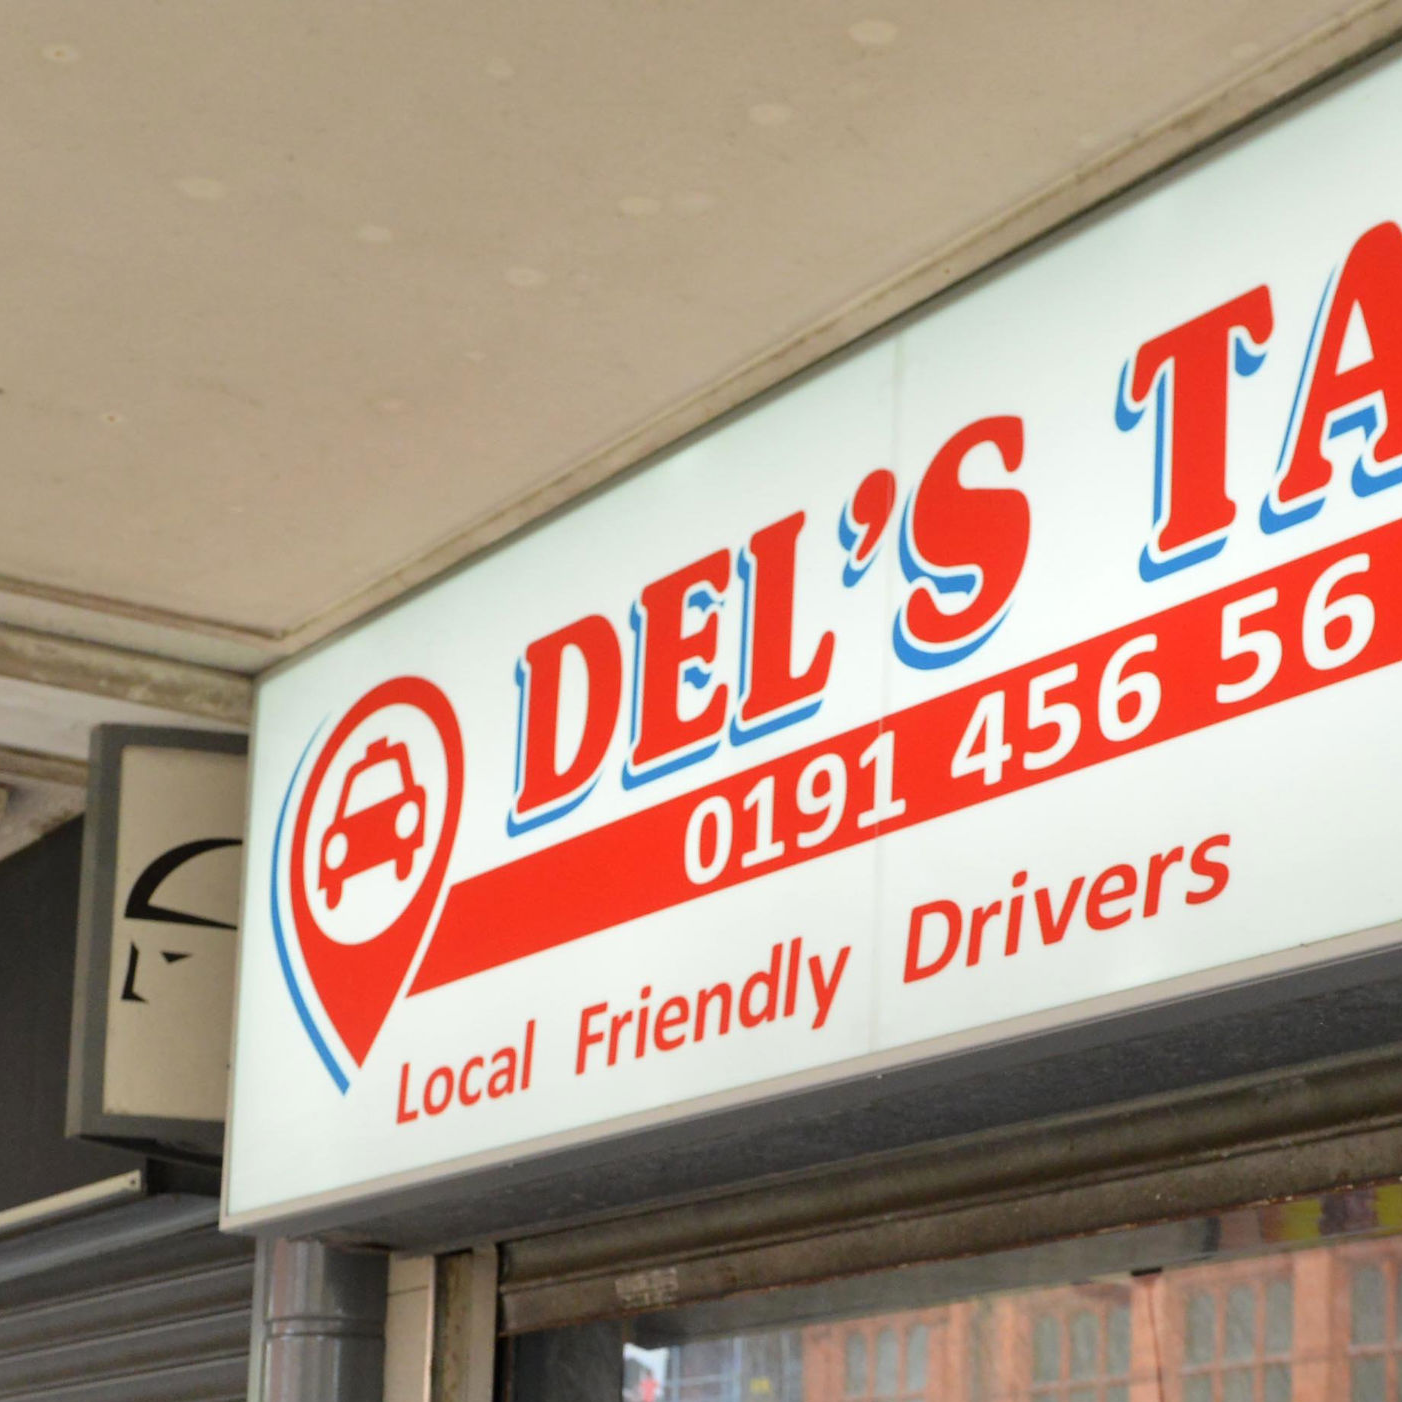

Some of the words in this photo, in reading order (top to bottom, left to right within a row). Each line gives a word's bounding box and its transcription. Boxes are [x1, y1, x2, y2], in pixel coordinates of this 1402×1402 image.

[506, 414, 1031, 839] DEL'S
[683, 730, 906, 888] 0191
[950, 633, 1163, 787] 456
[1214, 550, 1376, 704] 56
[394, 1020, 535, 1125] Local
[573, 937, 850, 1077] Friendly
[901, 830, 1231, 985] Drivers
